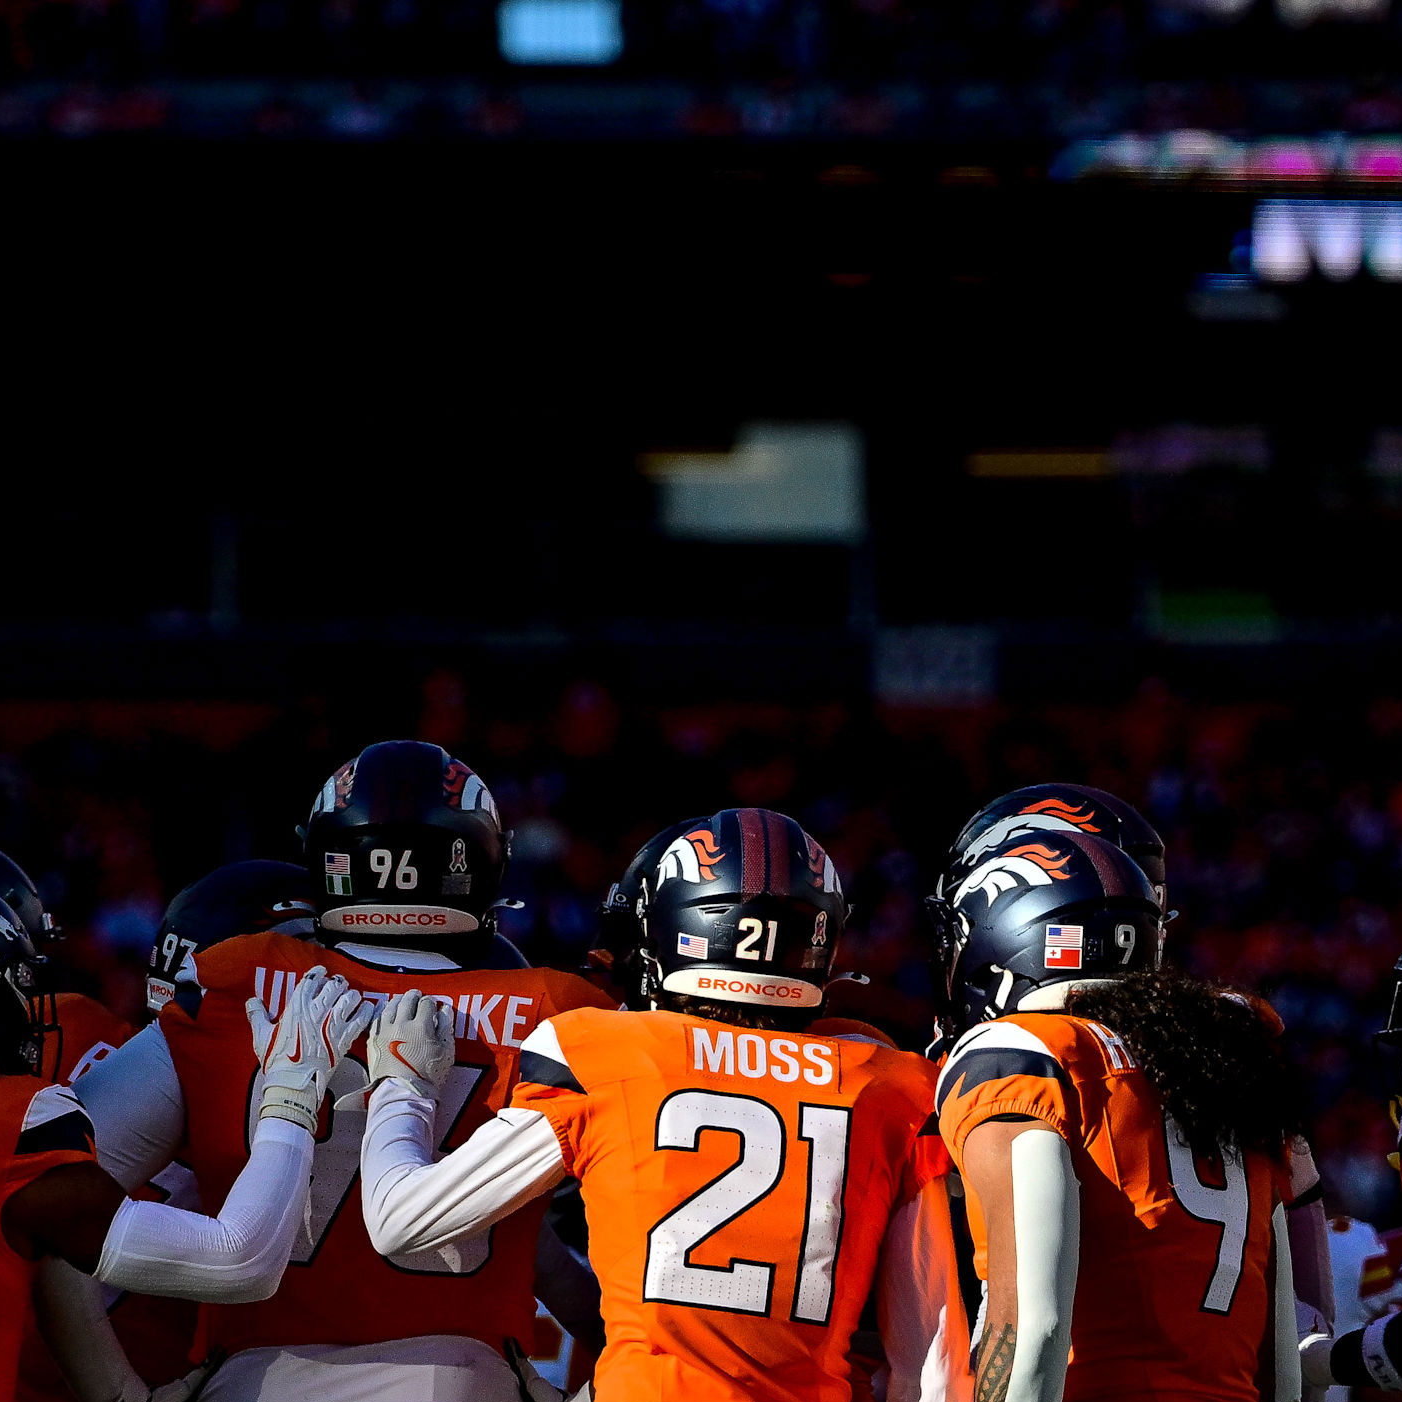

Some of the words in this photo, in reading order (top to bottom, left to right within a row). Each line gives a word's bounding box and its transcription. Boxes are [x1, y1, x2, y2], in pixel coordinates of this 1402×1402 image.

[369, 848, 418, 890] 96
[341, 913, 447, 927] BRONCOS
[735, 917, 778, 962] 21
[1115, 923, 1137, 965] 9
[698, 976, 803, 1000] BRONCOS
[692, 1027, 834, 1086] MOSS
[643, 1087, 854, 1327] 21
